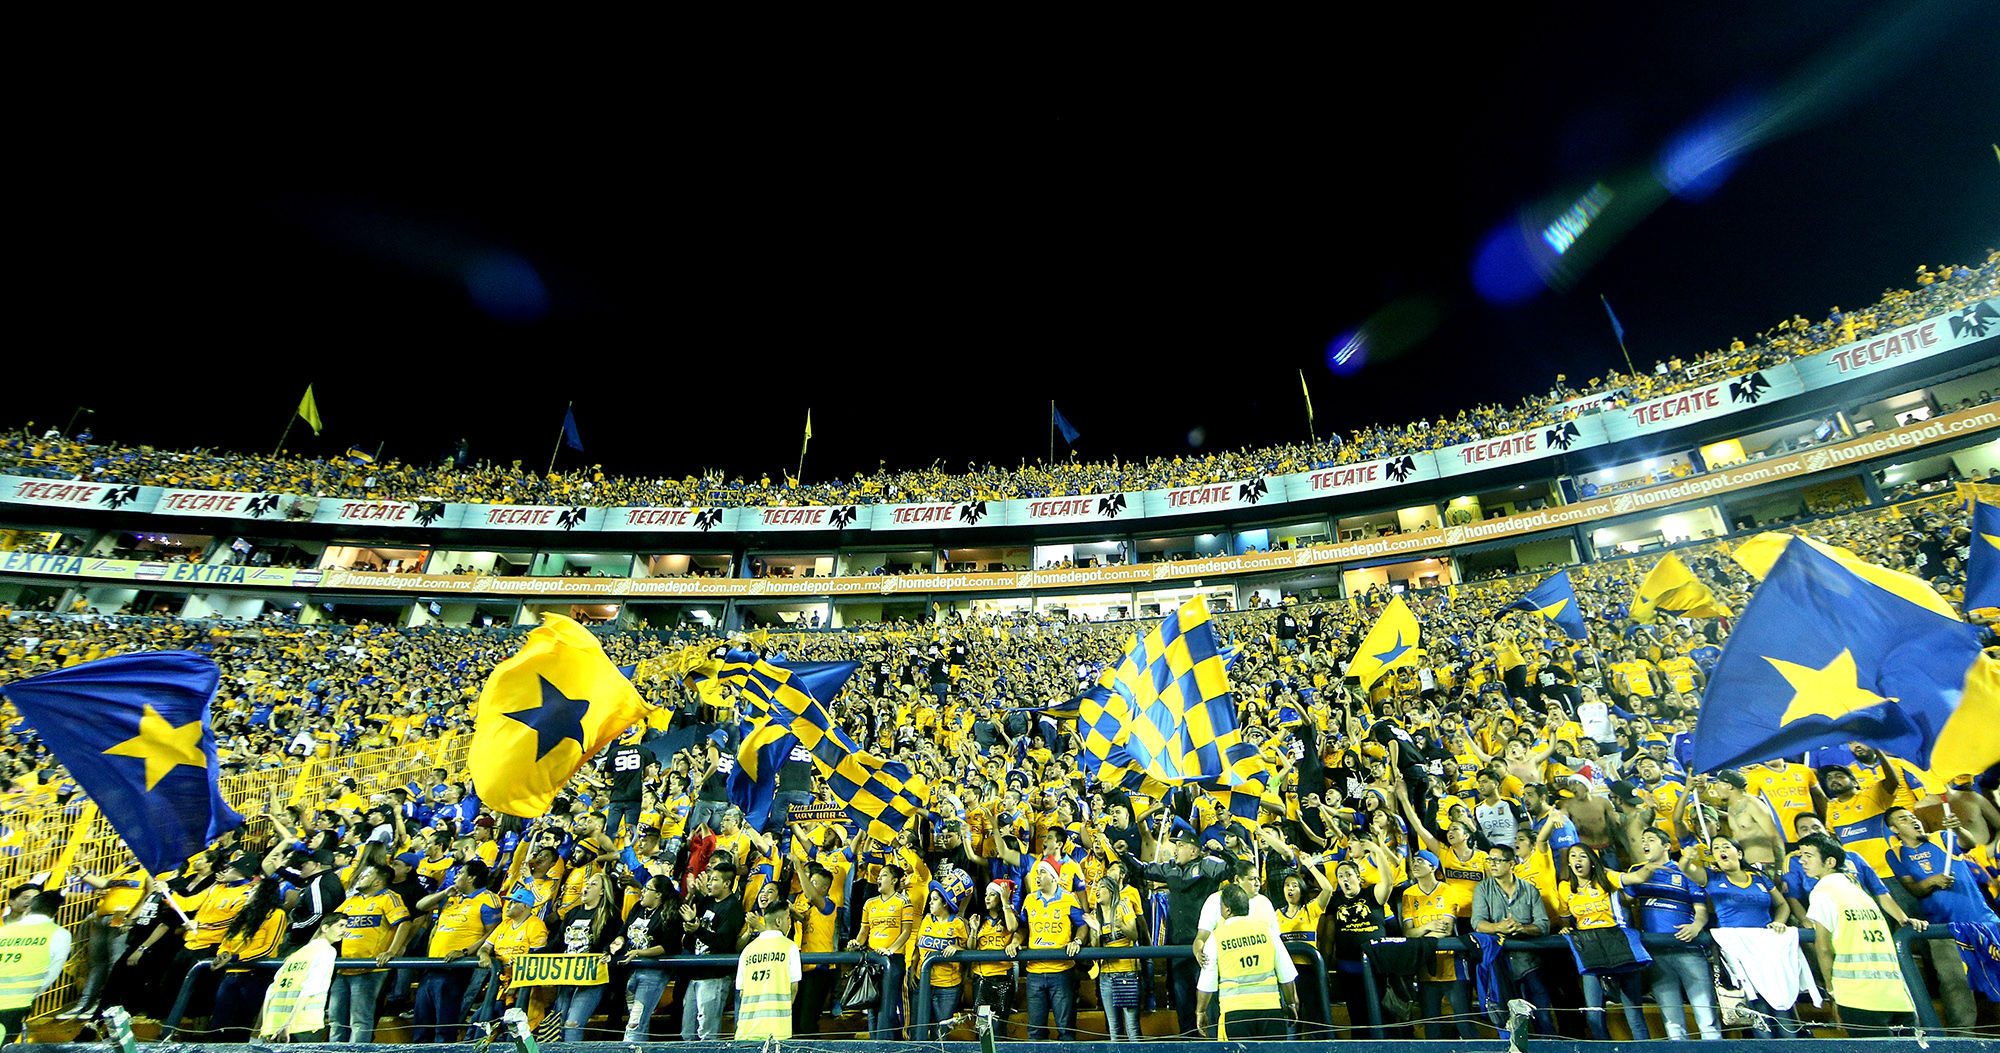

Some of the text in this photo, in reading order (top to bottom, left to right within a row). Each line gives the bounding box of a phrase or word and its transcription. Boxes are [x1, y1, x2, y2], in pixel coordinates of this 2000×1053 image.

[1829, 323, 1939, 373] TECATE
[1629, 388, 1719, 427] TECATE
[1458, 433, 1537, 465] TECATE
[1308, 464, 1379, 491] TECATE
[1633, 459, 1801, 507] homedepot.com.mx
[16, 481, 101, 502] TECATE
[1165, 485, 1233, 508] TECATE
[165, 492, 244, 513] TECATE
[340, 503, 411, 520] TECATE
[1027, 498, 1093, 518] TECATE
[485, 508, 555, 525] TECATE
[626, 510, 692, 525] TECATE
[760, 509, 826, 525] TECATE
[890, 505, 956, 524] TECATE
[1464, 503, 1609, 538] homedepot.com.mx
[1312, 533, 1443, 562] homedepot.com.mx
[4, 552, 83, 575] EXTRA
[173, 563, 246, 584] EXTRA
[1170, 554, 1292, 577] homedepot.com.mx
[346, 573, 471, 589] homedepot.com.mx
[492, 578, 611, 594] homedepot.com.mx
[630, 580, 746, 594] homedepot.com.mx
[766, 579, 881, 594] homedepot.com.mx
[899, 575, 1014, 592] homedepot.com.mx
[1033, 567, 1151, 587] homedepot.com.mx
[615, 753, 640, 771] 98
[790, 747, 811, 762] 98
[1221, 933, 1267, 951] SEGURIDAD
[515, 956, 599, 981] HOUSTON
[1240, 954, 1259, 968] 107
[752, 969, 771, 981] 475
